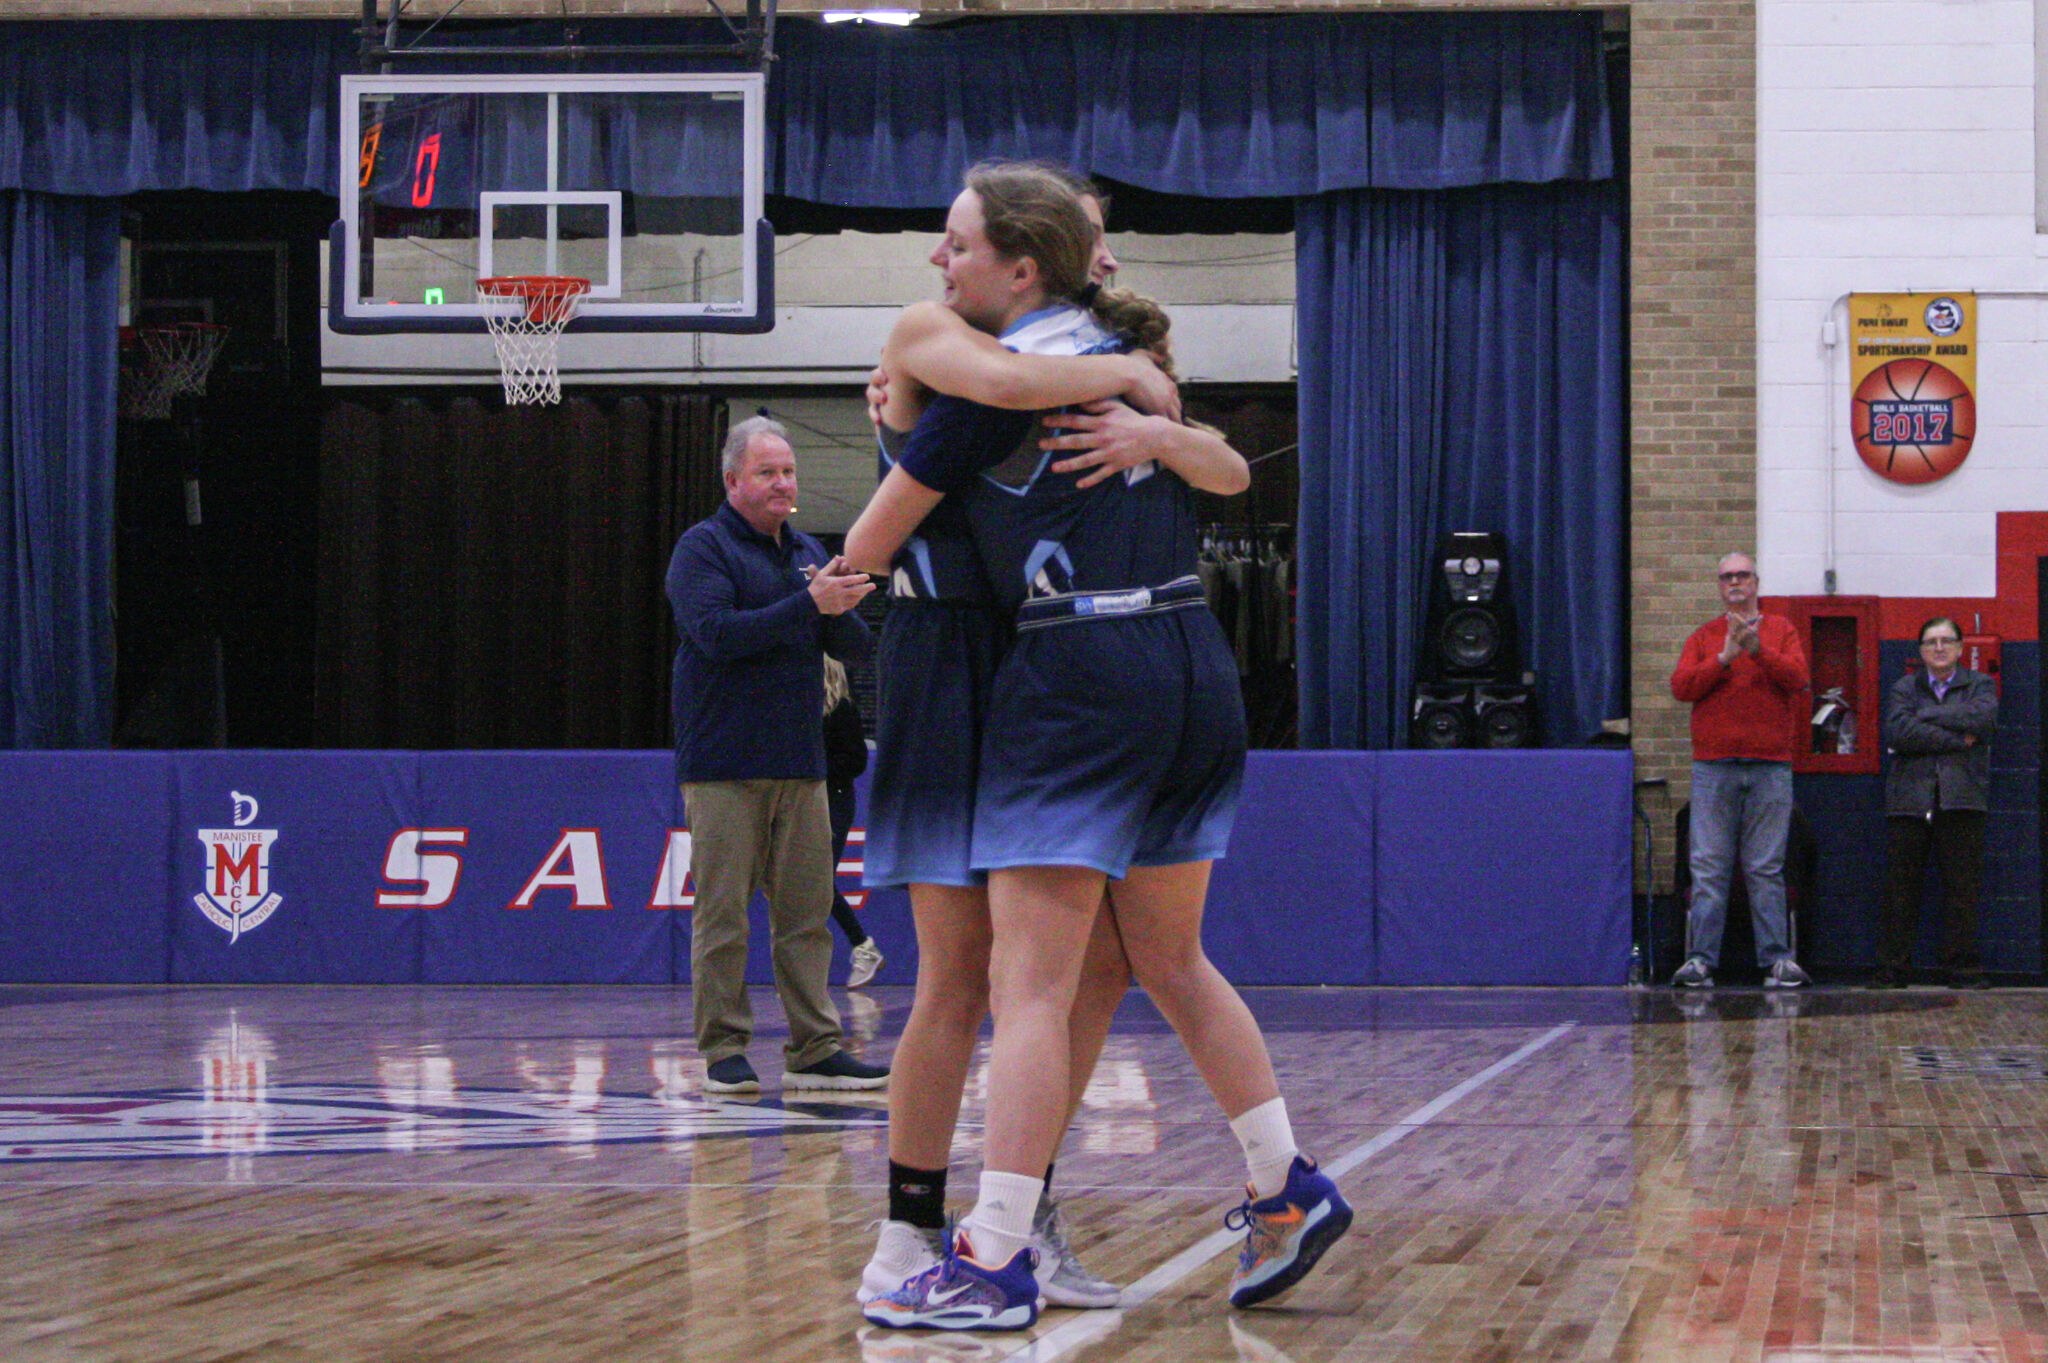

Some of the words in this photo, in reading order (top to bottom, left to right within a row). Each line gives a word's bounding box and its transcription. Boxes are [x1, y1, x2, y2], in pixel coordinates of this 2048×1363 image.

[1858, 345, 1932, 356] SPORTSMANSHIP
[1935, 345, 1968, 355] AWARD
[1873, 404, 1895, 412] GIRLS
[1899, 404, 1949, 412] BASKETBALL
[1873, 413, 1948, 441] 2017
[213, 832, 263, 842] MANISTEE
[197, 896, 231, 929] CATHOLIC
[242, 897, 278, 929] CENTRAL
